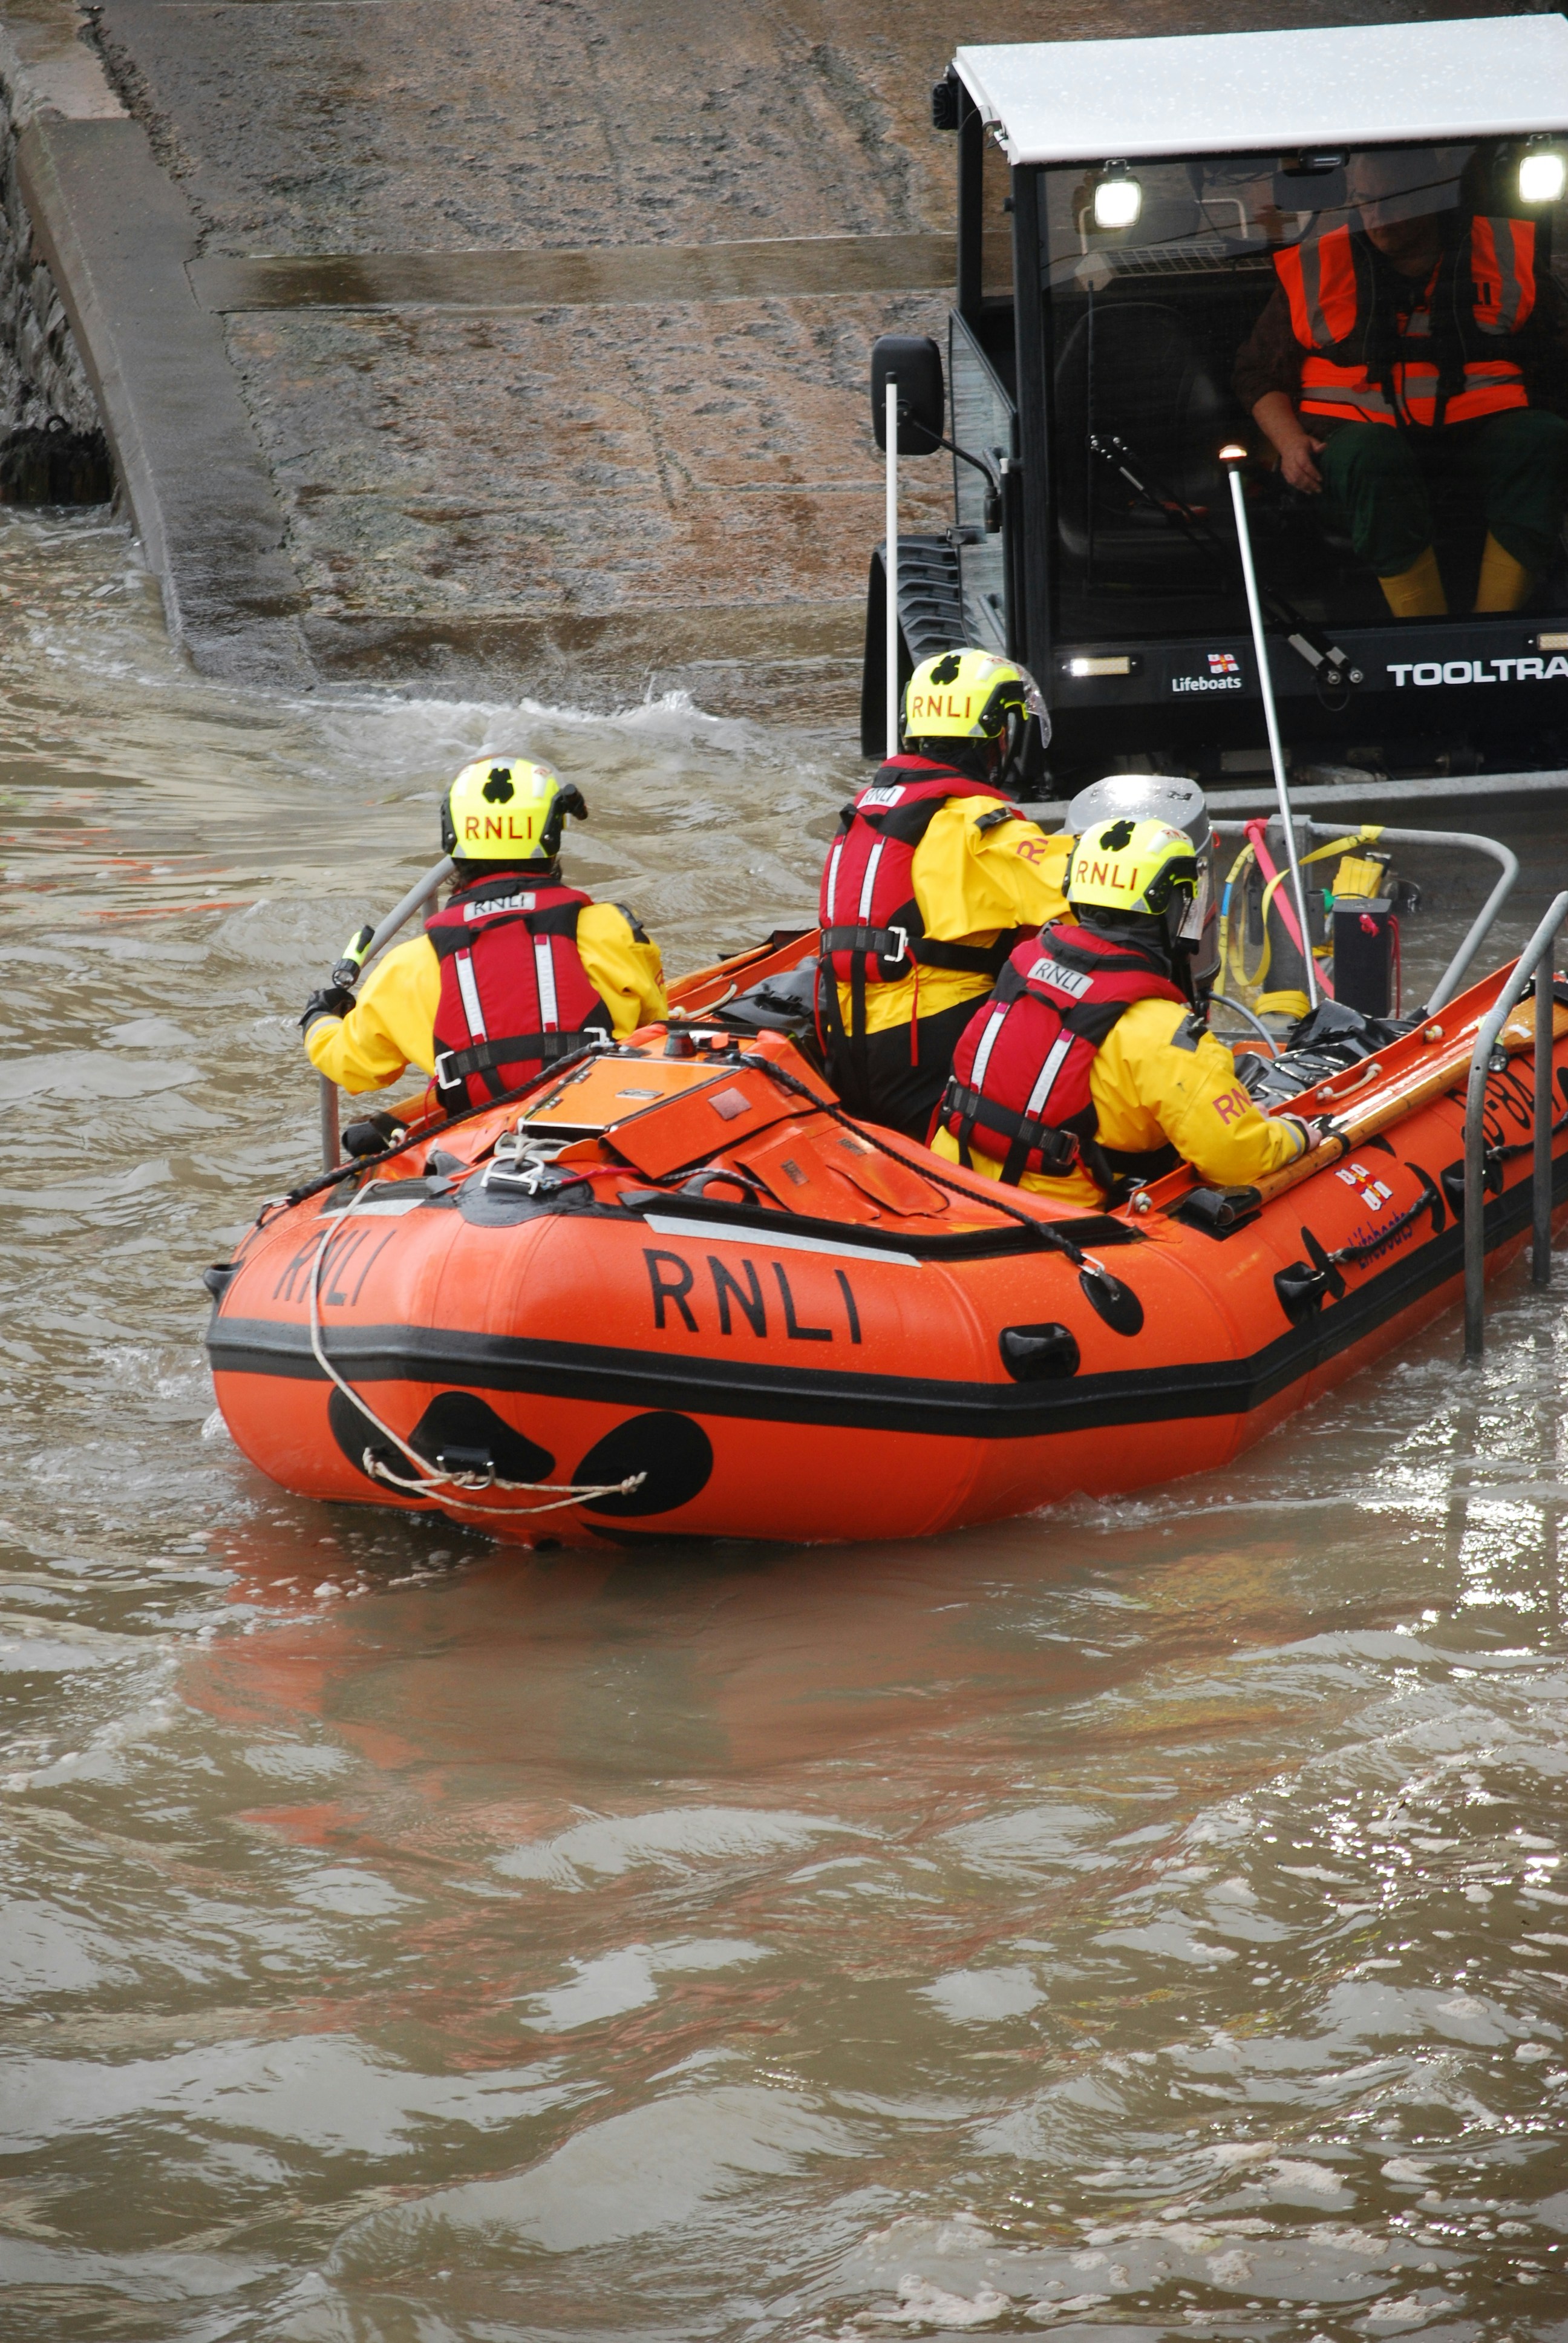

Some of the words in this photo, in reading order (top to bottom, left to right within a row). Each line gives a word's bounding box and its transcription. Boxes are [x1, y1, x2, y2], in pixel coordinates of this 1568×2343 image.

[1172, 677, 1243, 692] Lifeboats
[1387, 657, 1568, 687] TOOLTRA
[912, 695, 971, 718] RNLI
[465, 816, 532, 840] RNLI
[1076, 860, 1138, 891] RNLI
[474, 895, 524, 916] RNLI
[1035, 962, 1083, 992] RNLI
[272, 1229, 397, 1306] RNLI
[642, 1248, 863, 1345] RNLI
